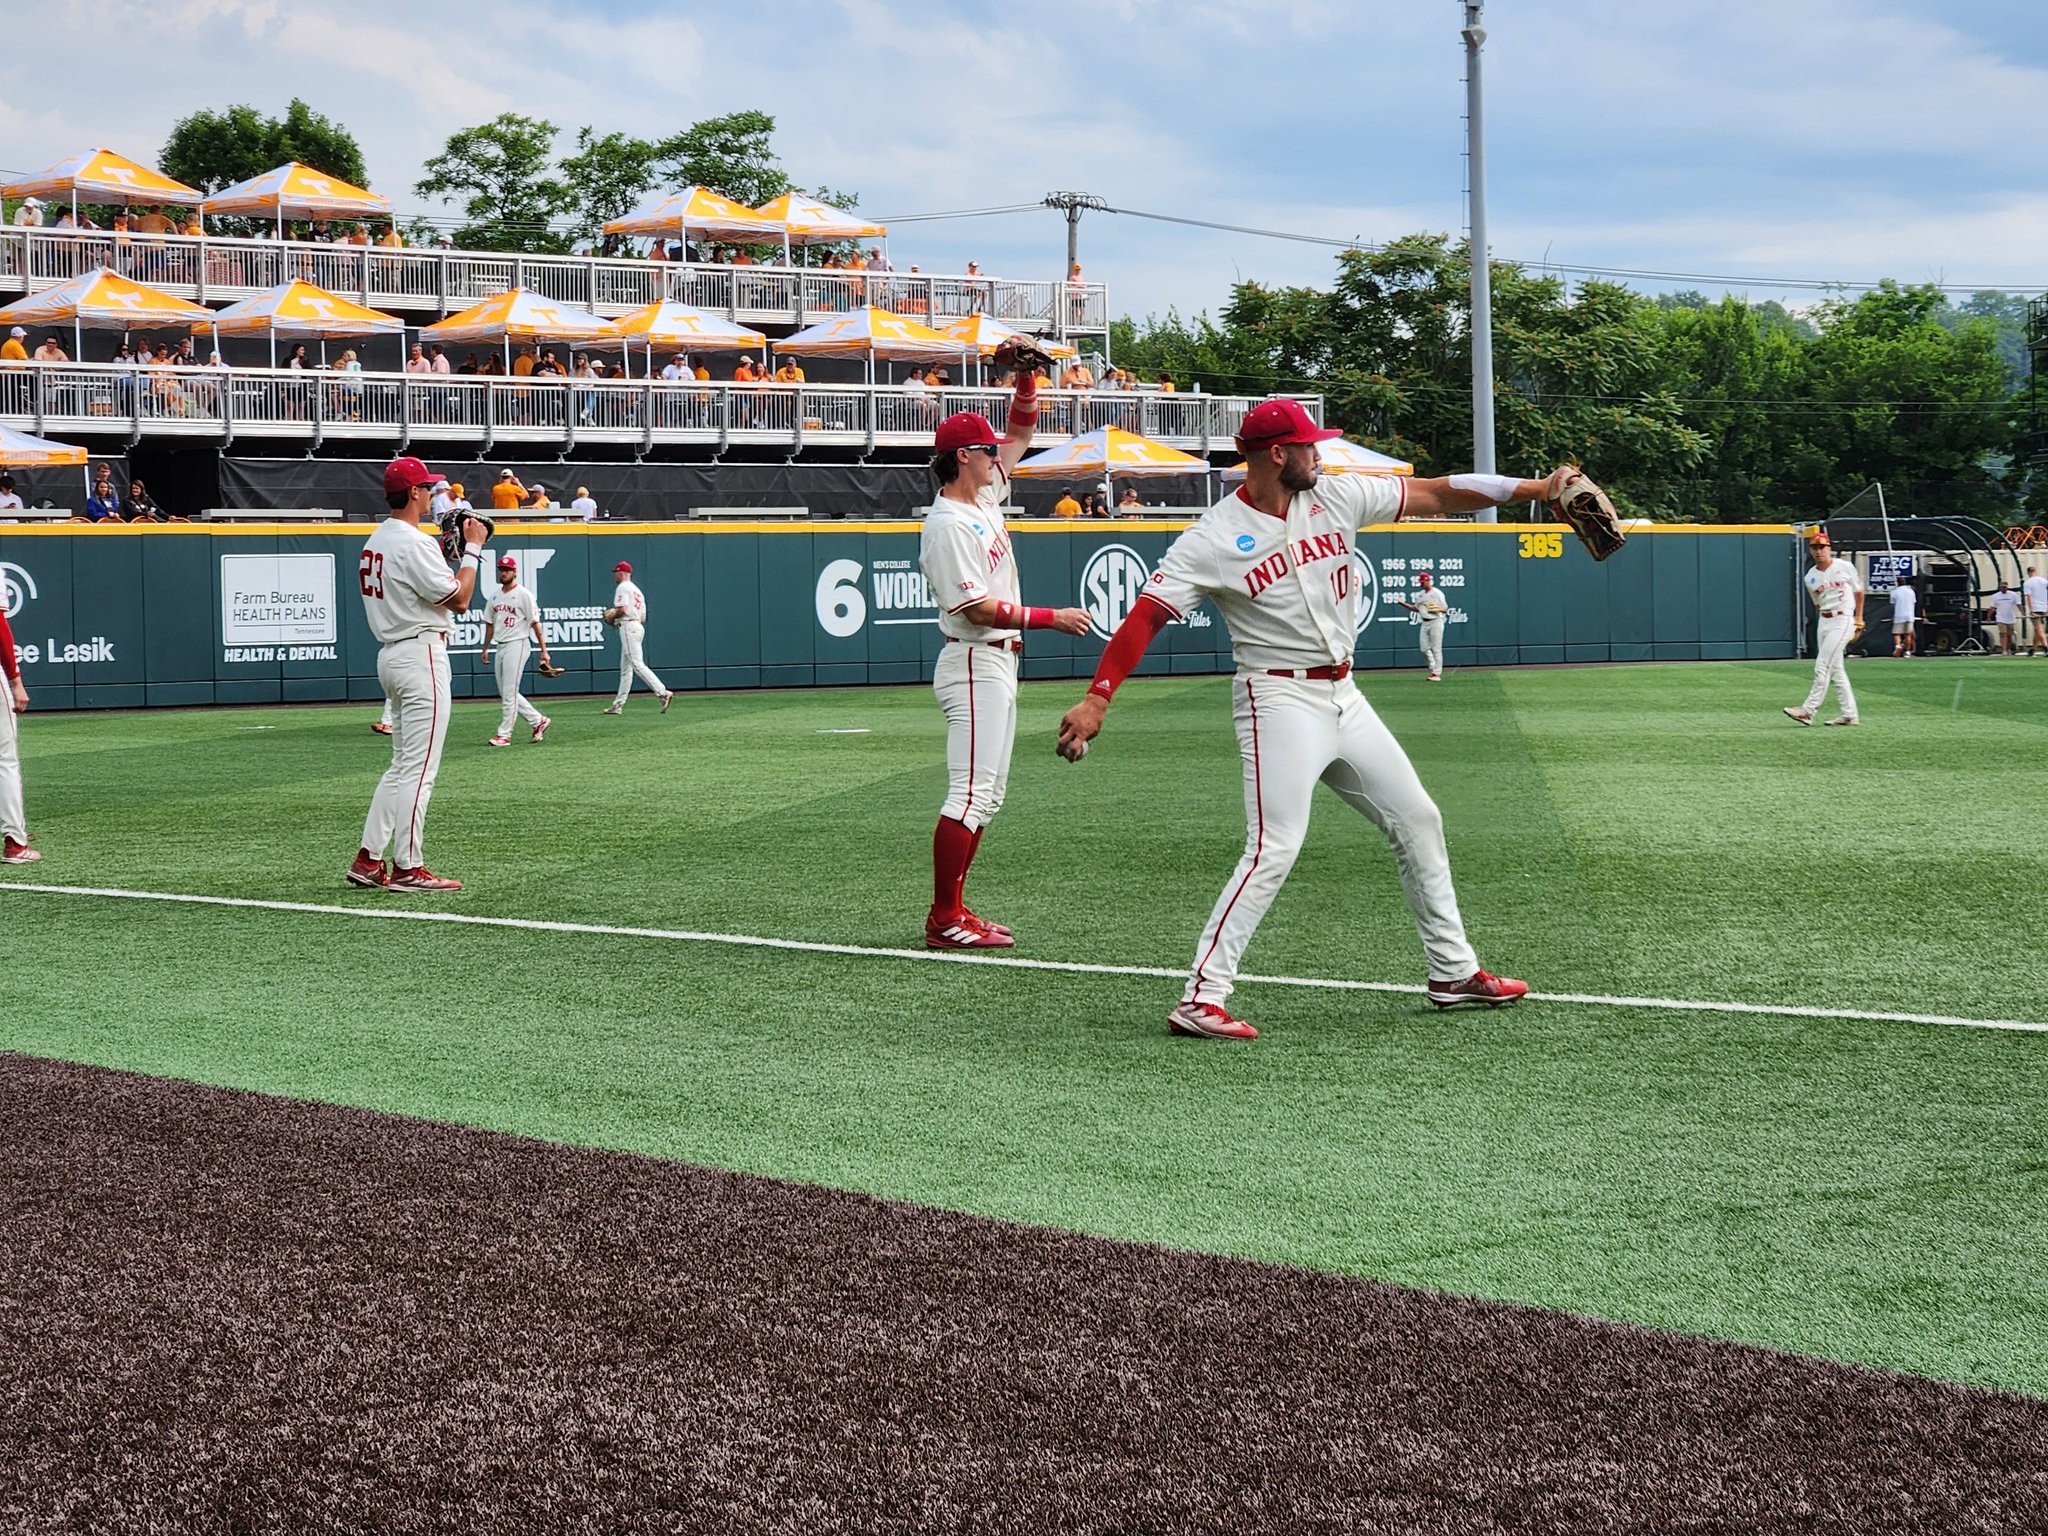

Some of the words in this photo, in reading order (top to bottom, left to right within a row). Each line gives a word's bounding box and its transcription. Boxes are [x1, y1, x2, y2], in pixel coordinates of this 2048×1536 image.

[671, 316, 704, 332] T
[1117, 443, 1155, 461] T
[1518, 533, 1563, 558] 385
[1243, 531, 1349, 600] INDIANA
[1381, 559, 1406, 570] 1966
[1409, 559, 1434, 570] 1994
[1438, 559, 1463, 570] 2021
[1879, 557, 1911, 569] TEG
[359, 549, 384, 600] 23
[1381, 575, 1406, 587] 1970
[1439, 575, 1465, 587] 2022
[873, 572, 939, 609] WORL
[1330, 564, 1349, 606] 10
[234, 592, 267, 604] Farm
[270, 591, 314, 604] Bureau
[815, 558, 867, 638] 6
[233, 608, 281, 621] HEALTH
[285, 607, 326, 620] PLANS
[542, 606, 604, 620] TENNESSEE
[1187, 611, 1212, 629] Titles
[1446, 608, 1468, 624] Titles
[503, 616, 516, 627] 40
[47, 636, 116, 663] Lasik
[224, 647, 275, 662] HEALTH
[276, 647, 286, 661] &
[289, 646, 338, 661] DENTAL
